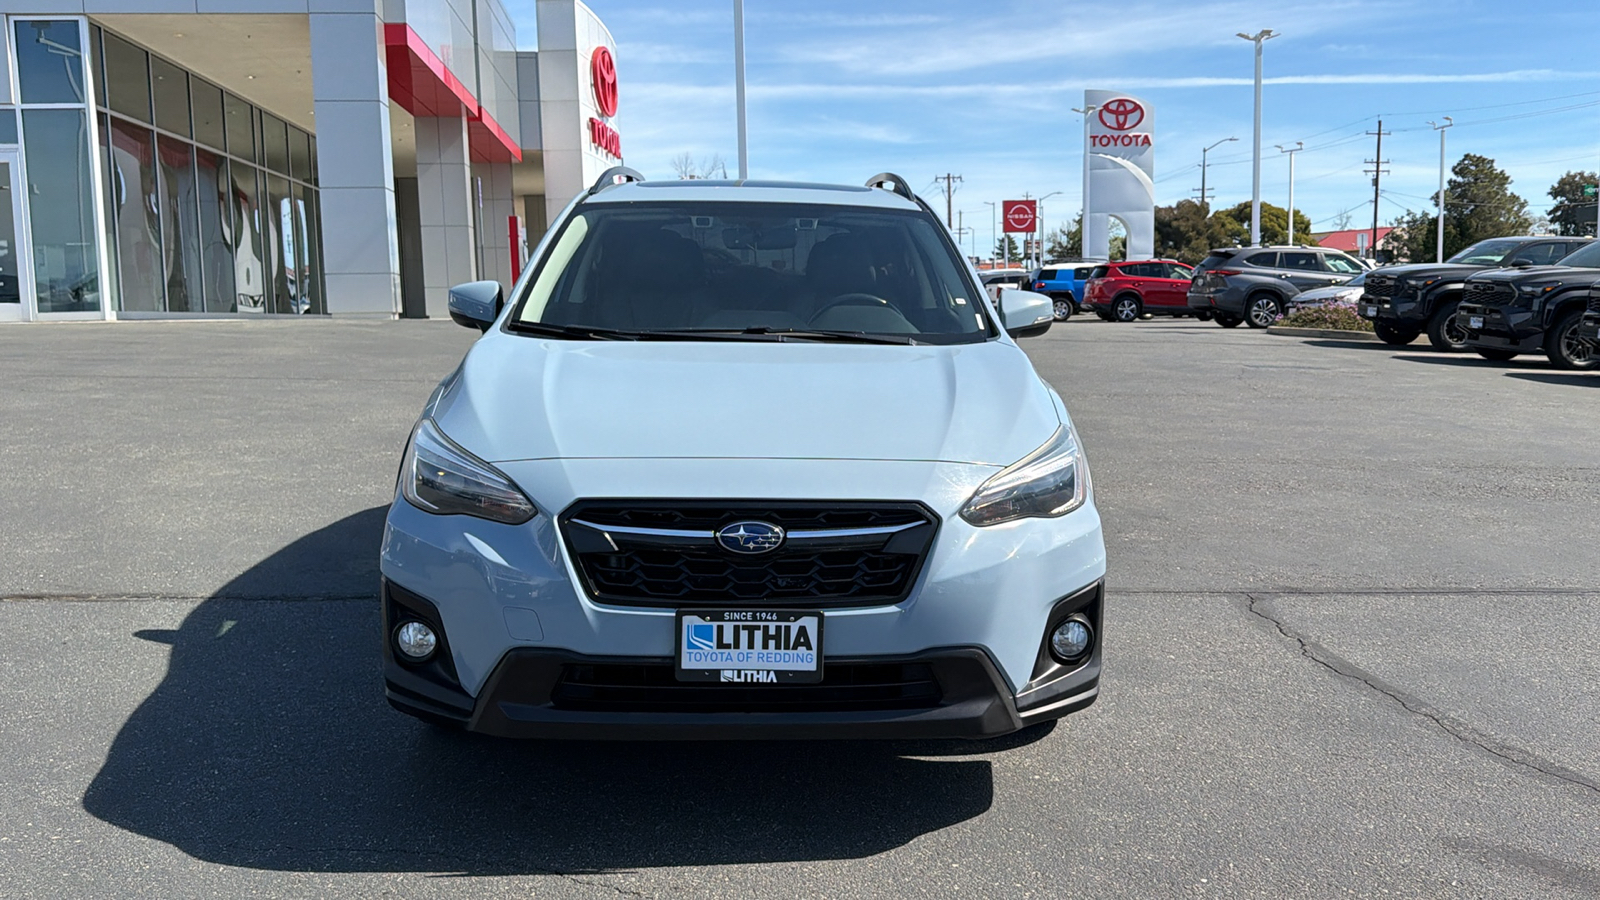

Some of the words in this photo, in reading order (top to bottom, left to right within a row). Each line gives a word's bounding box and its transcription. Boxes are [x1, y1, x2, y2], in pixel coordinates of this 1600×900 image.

[1090, 134, 1151, 147] TOYOTA
[724, 612, 752, 620] SINCE
[756, 612, 777, 620] 1946
[716, 625, 812, 650] LITHIA
[687, 652, 733, 662] TOYOTA
[737, 652, 753, 662] OF
[757, 653, 813, 663] REDDING
[733, 670, 777, 682] LITHIA
